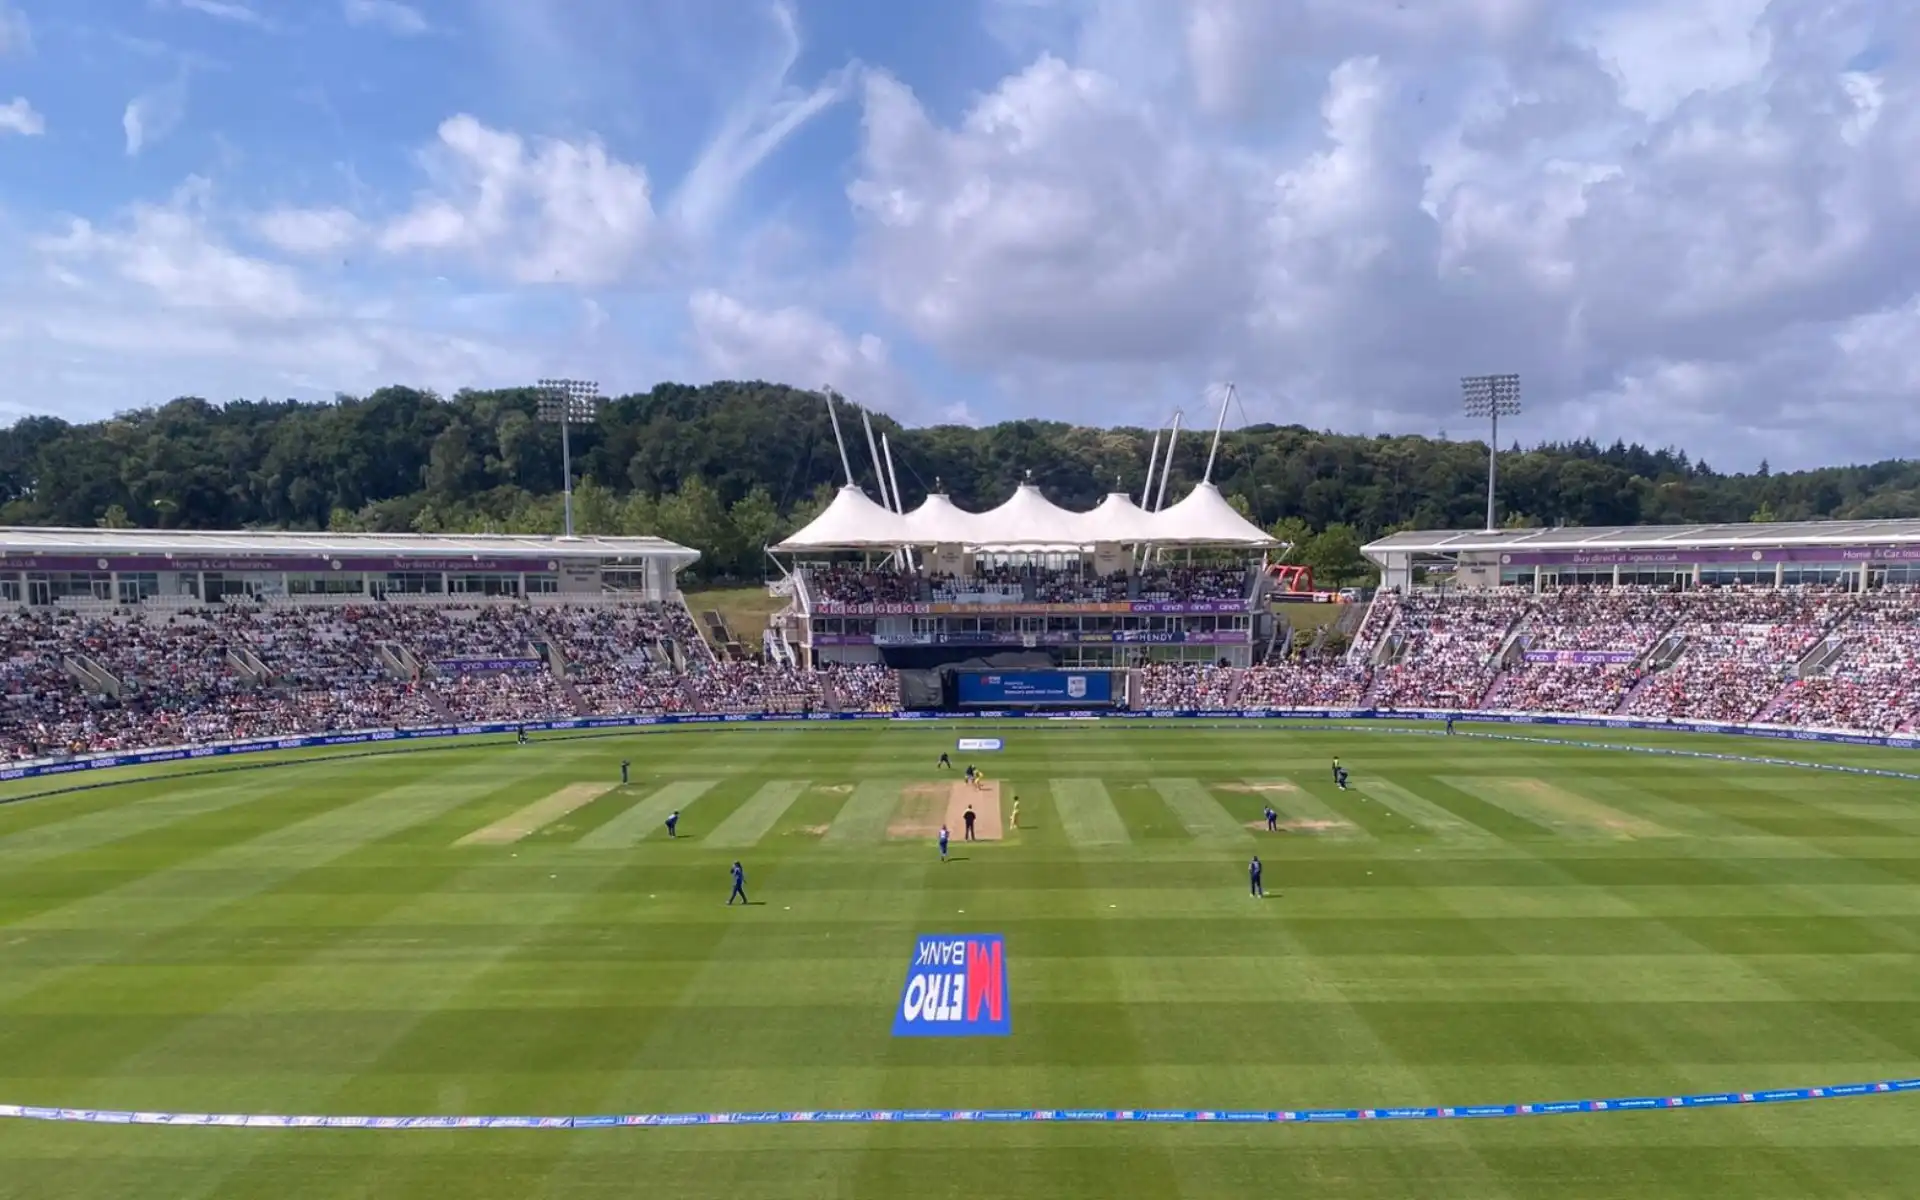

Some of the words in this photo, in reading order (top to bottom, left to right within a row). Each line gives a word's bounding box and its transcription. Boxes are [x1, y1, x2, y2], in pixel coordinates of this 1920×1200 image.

[1573, 552, 1590, 563] Buy
[1591, 552, 1616, 562] direct
[1843, 549, 1871, 559] Home
[1884, 549, 1900, 558] Car
[171, 560, 199, 569] Home
[1133, 603, 1156, 611] cinch
[1162, 603, 1184, 611] cinch
[1190, 603, 1213, 611] cinch
[1219, 603, 1241, 611] cinch
[1139, 633, 1173, 642] HENDY
[915, 941, 965, 966] BANK
[904, 940, 1002, 1022] METRO
